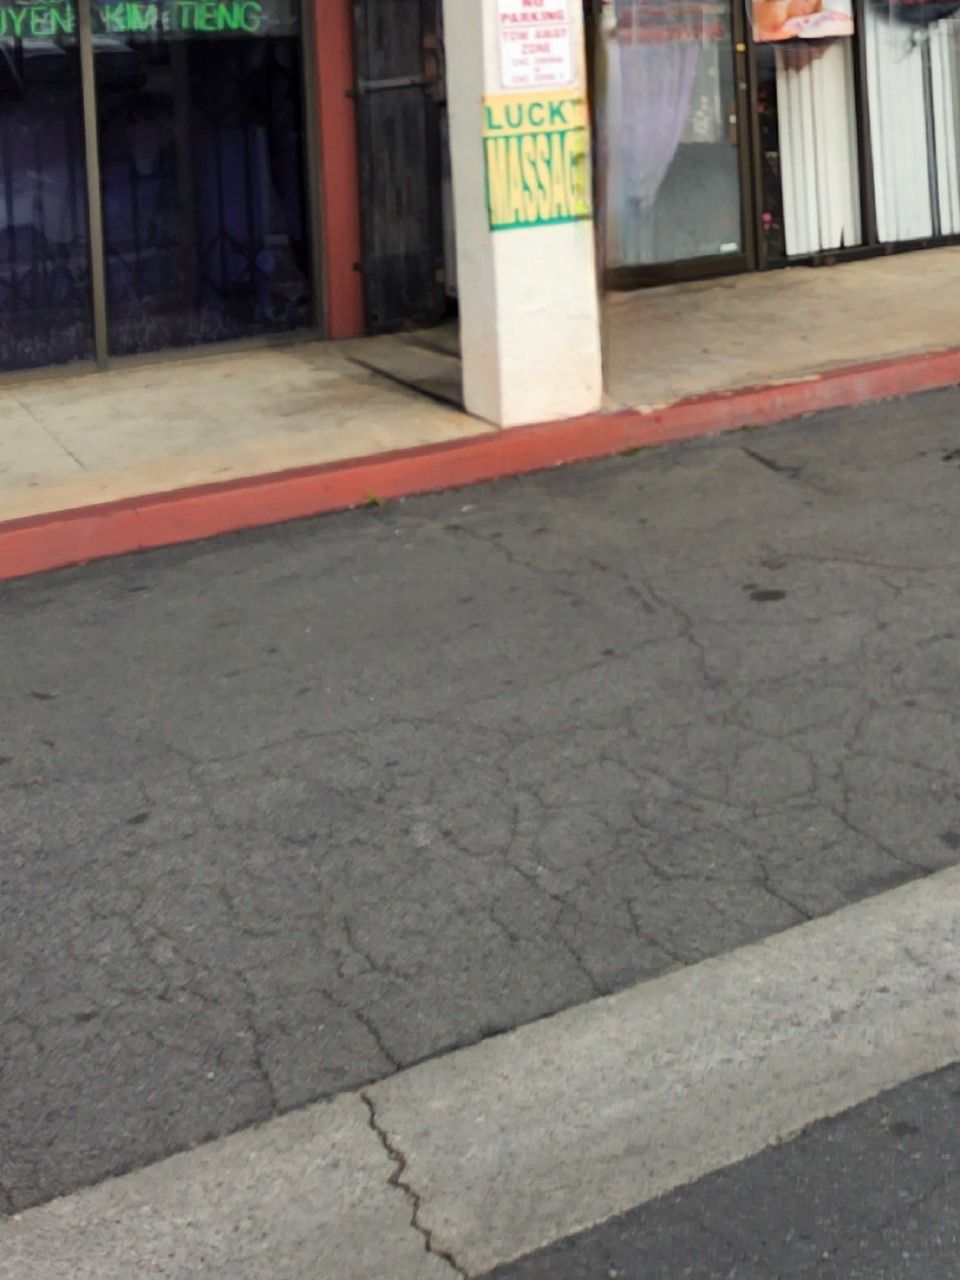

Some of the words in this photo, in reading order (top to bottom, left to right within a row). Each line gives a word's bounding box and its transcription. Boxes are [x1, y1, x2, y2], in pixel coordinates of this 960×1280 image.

[501, 10, 565, 23] PARKING
[503, 30, 529, 41] TOW
[521, 43, 551, 54] ZONE
